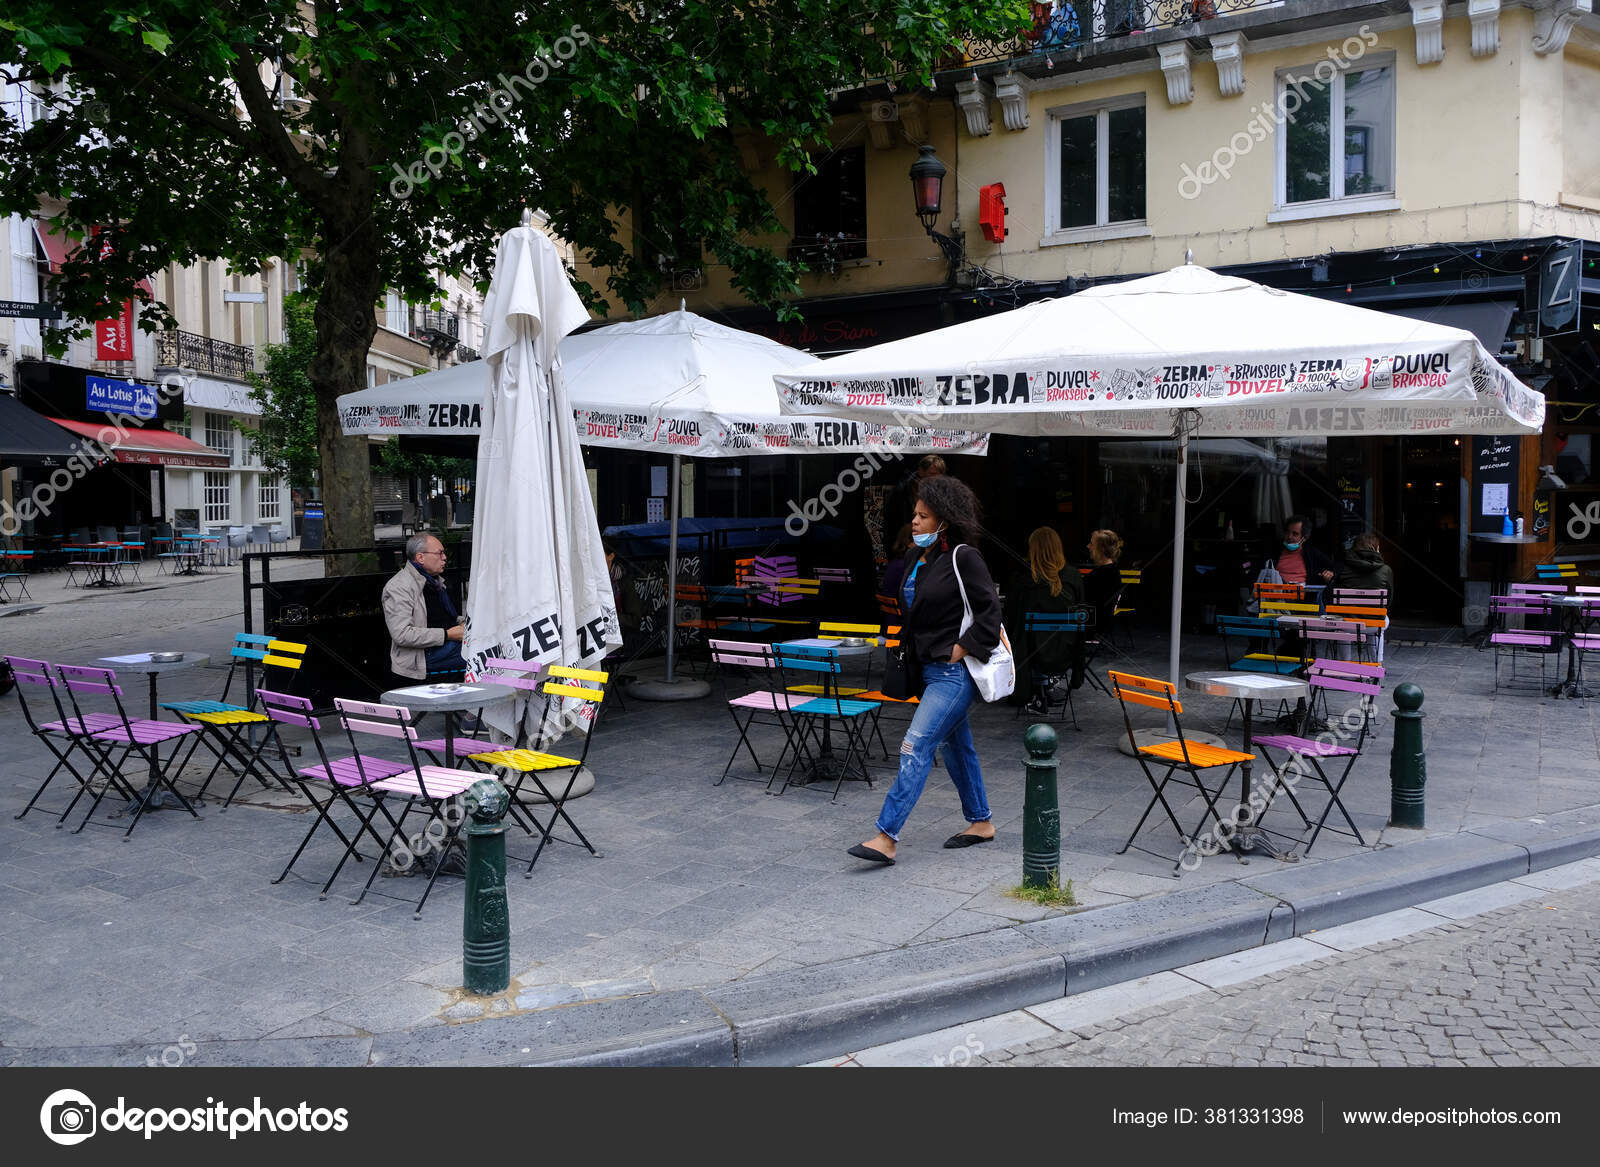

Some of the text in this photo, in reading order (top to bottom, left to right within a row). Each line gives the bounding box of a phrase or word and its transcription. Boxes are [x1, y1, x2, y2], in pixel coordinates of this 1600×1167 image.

[1547, 255, 1573, 308] Z
[103, 327, 117, 351] Au
[823, 320, 878, 344] Siam
[1163, 365, 1207, 382] ZEBRA
[1300, 359, 1343, 374] ZEBRA
[1307, 373, 1330, 382] 1000
[90, 382, 105, 398] Au
[107, 384, 133, 402] Lotus
[800, 381, 833, 394] ZEBRA
[935, 372, 1030, 406] ZEBRA
[1155, 383, 1188, 399] 1000
[1226, 379, 1286, 396] DUVEL
[800, 394, 823, 405] 1000
[847, 393, 887, 406] DUVEL
[349, 406, 371, 417] ZEBRA
[428, 403, 482, 427] ZEBRA
[346, 416, 361, 428] 1000
[379, 416, 402, 427] DUVEL
[624, 413, 648, 425] ZEBRA
[586, 422, 619, 438] DUVEL
[733, 422, 756, 434] ZEBRA
[814, 422, 860, 446] ZEBRA
[732, 435, 751, 448] 1000
[764, 435, 790, 447] DUVEL
[932, 436, 952, 448] DUVEL
